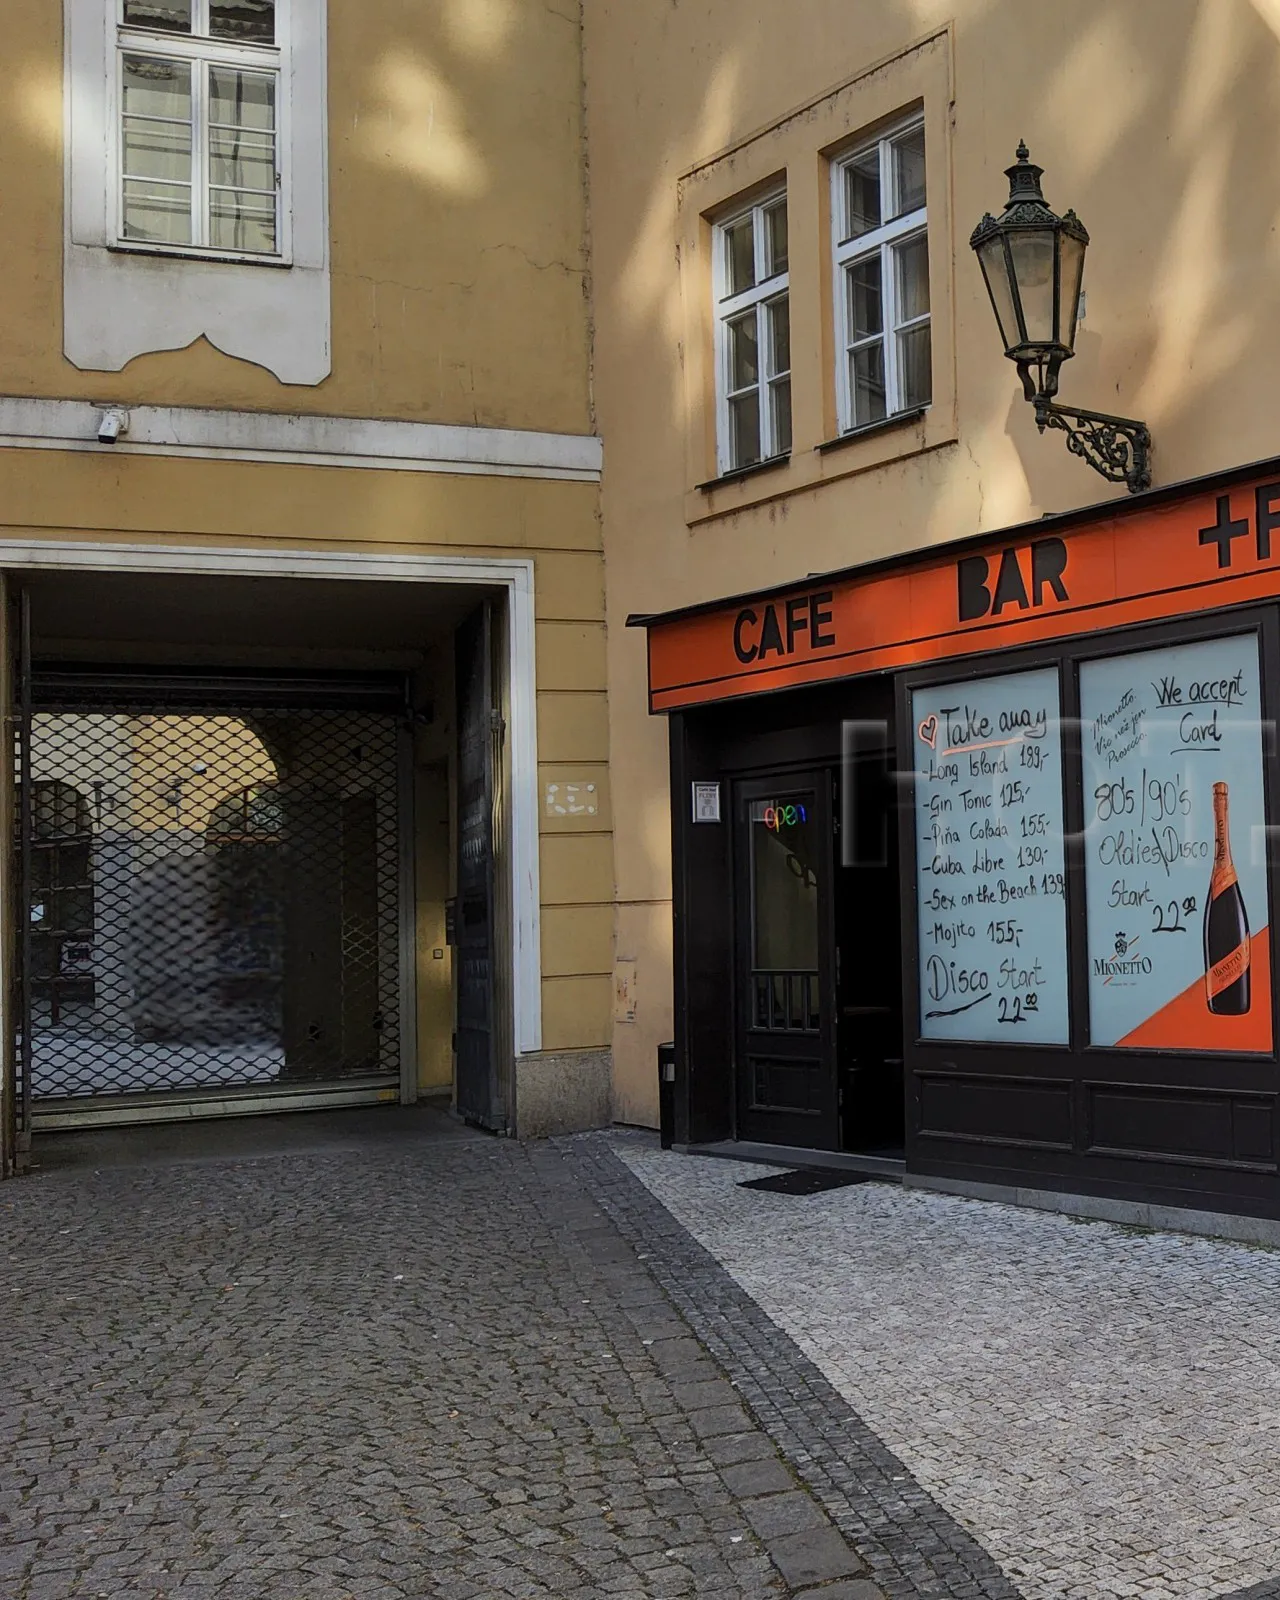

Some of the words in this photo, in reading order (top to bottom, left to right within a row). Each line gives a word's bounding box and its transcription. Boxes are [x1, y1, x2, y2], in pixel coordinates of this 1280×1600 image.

[732, 590, 836, 664] CAFE
[956, 537, 1070, 623] BAR
[1151, 676, 1182, 705] We
[1189, 669, 1247, 708] accept
[1179, 709, 1222, 744] Card
[969, 751, 1009, 777] Island
[958, 789, 992, 812] Tonic
[764, 804, 806, 833] open
[970, 818, 1009, 840] Colada
[972, 848, 1006, 873] Libre
[961, 892, 974, 906] on
[976, 884, 997, 903] the
[997, 874, 1037, 904] Beach
[1108, 879, 1154, 908] Start
[926, 954, 989, 1002] Disco
[997, 957, 1046, 990] Start
[1093, 957, 1152, 976] MIONETTO
